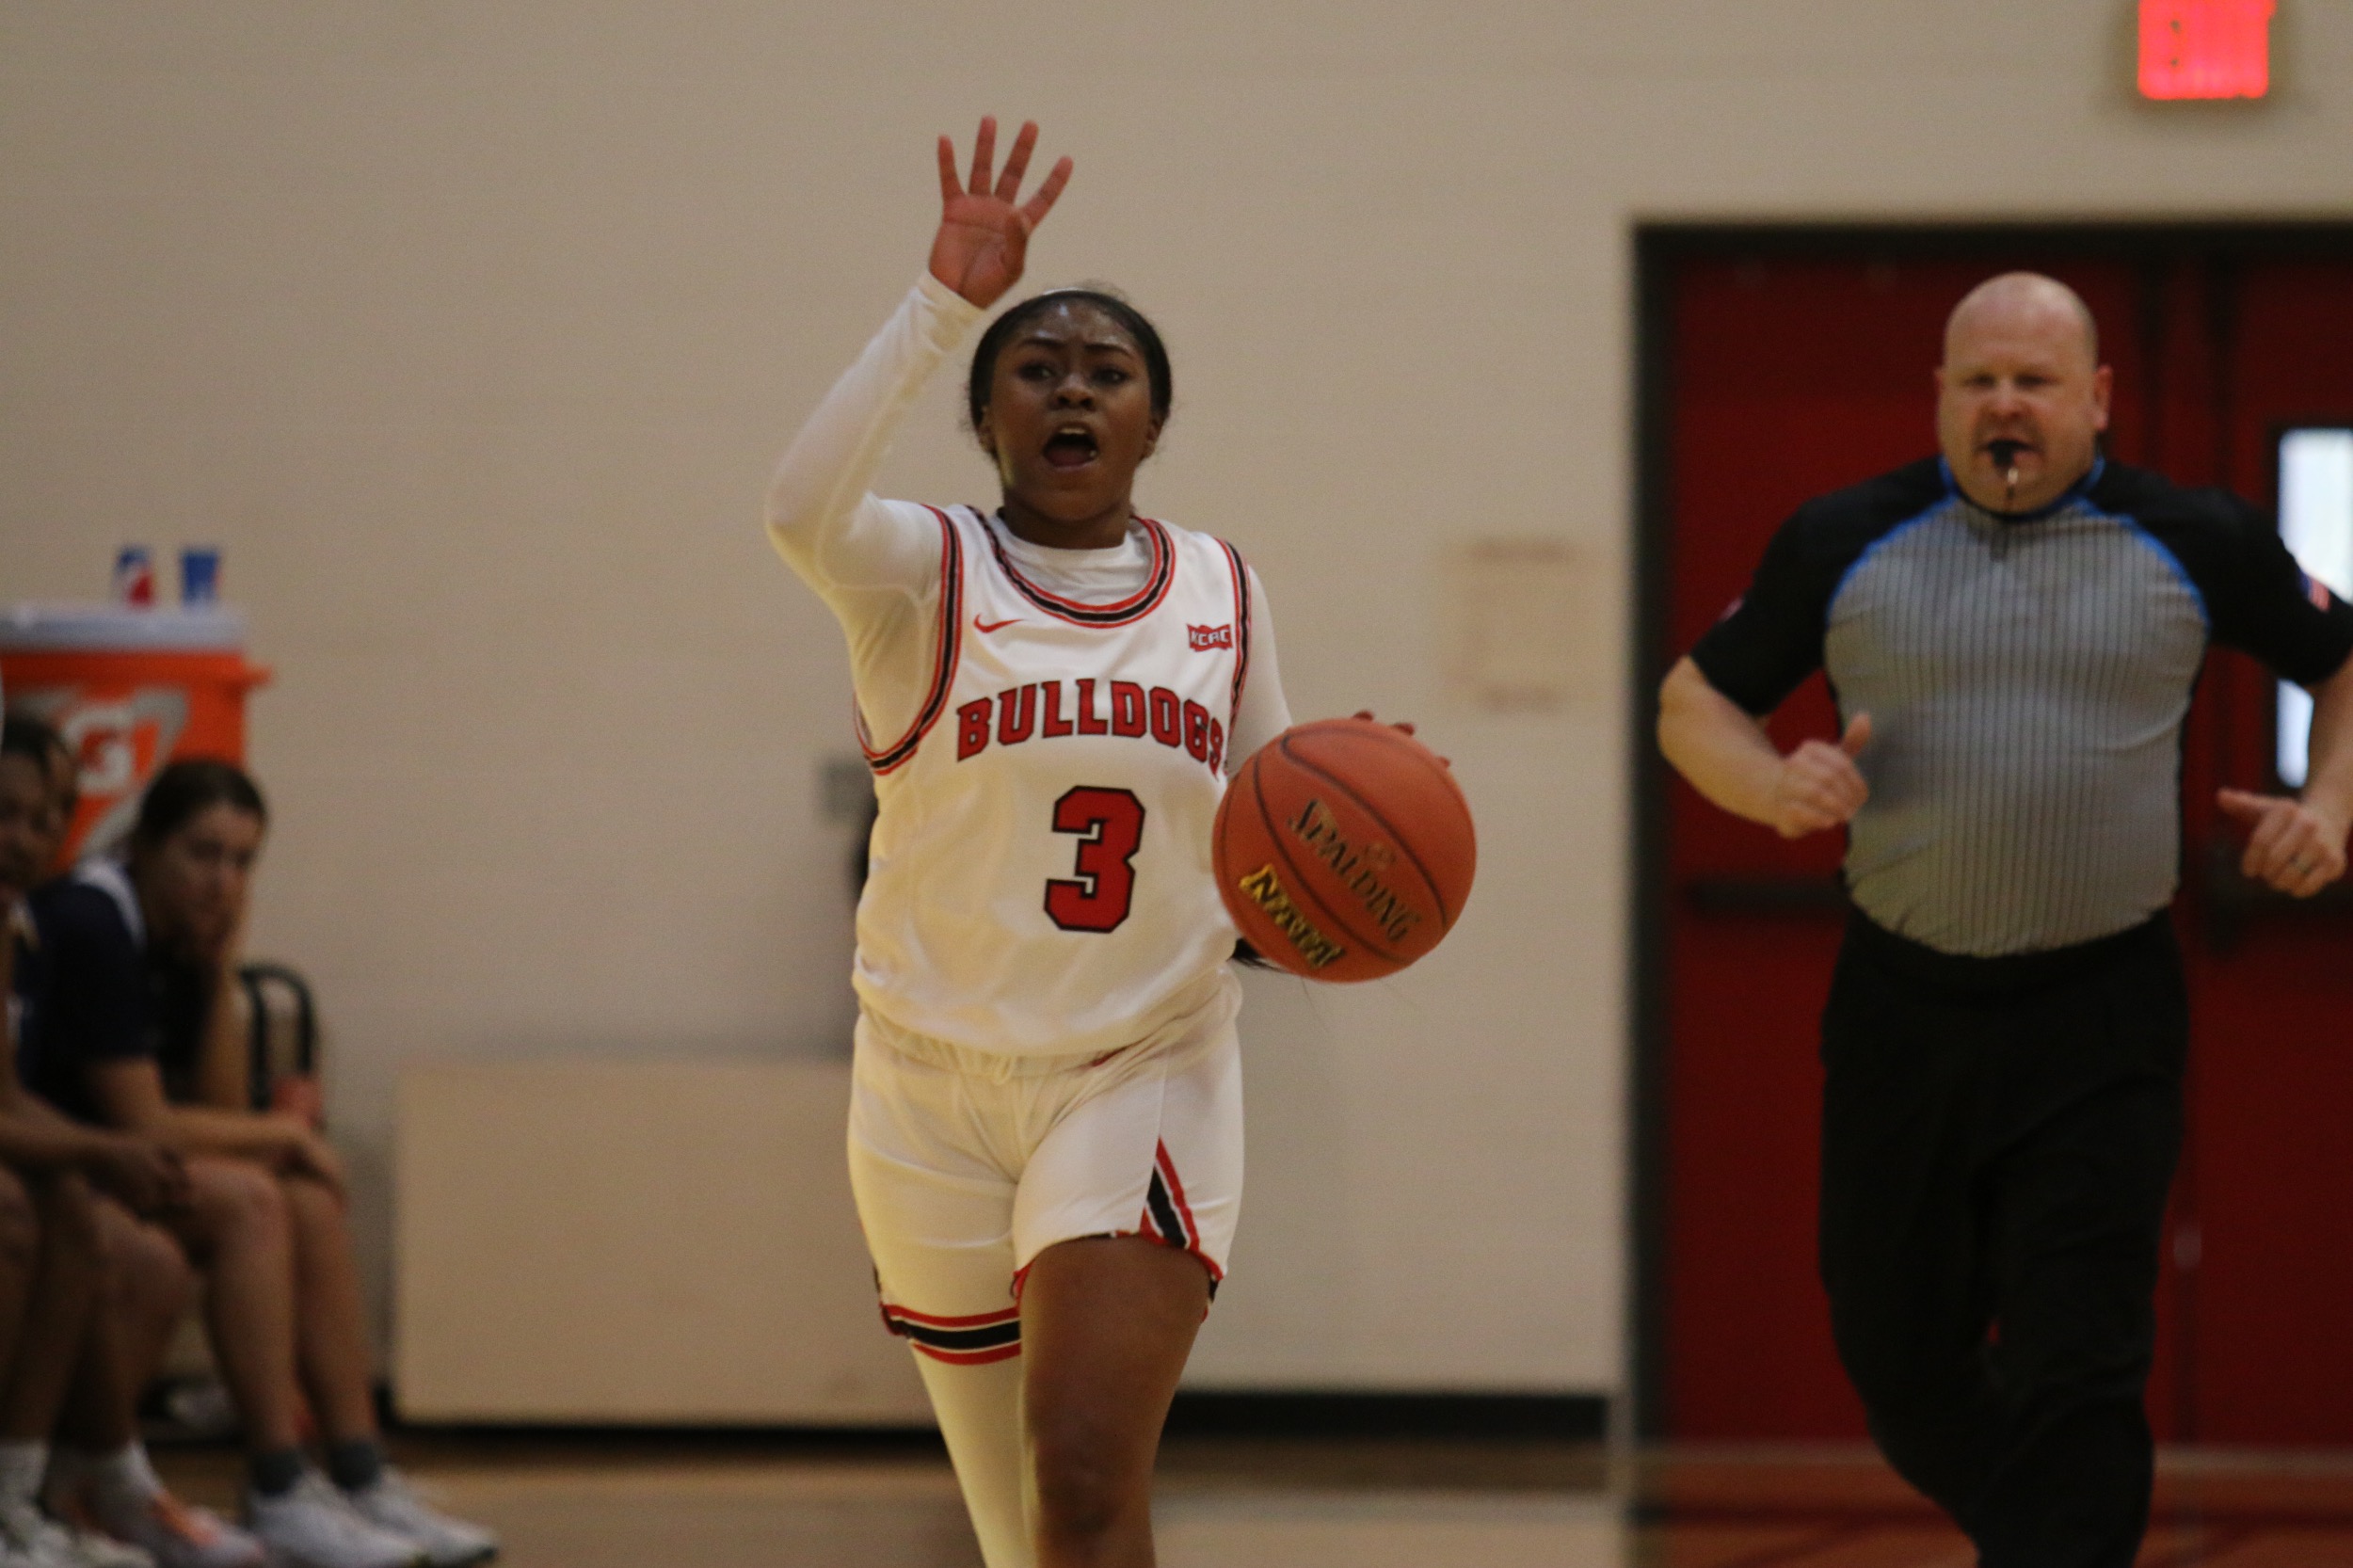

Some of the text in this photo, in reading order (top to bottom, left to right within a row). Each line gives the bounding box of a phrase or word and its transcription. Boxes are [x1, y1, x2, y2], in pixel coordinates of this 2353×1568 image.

[956, 678, 1224, 780] BULLDOGS
[1044, 785, 1145, 934] 3
[1288, 799, 1421, 942] SPALDING
